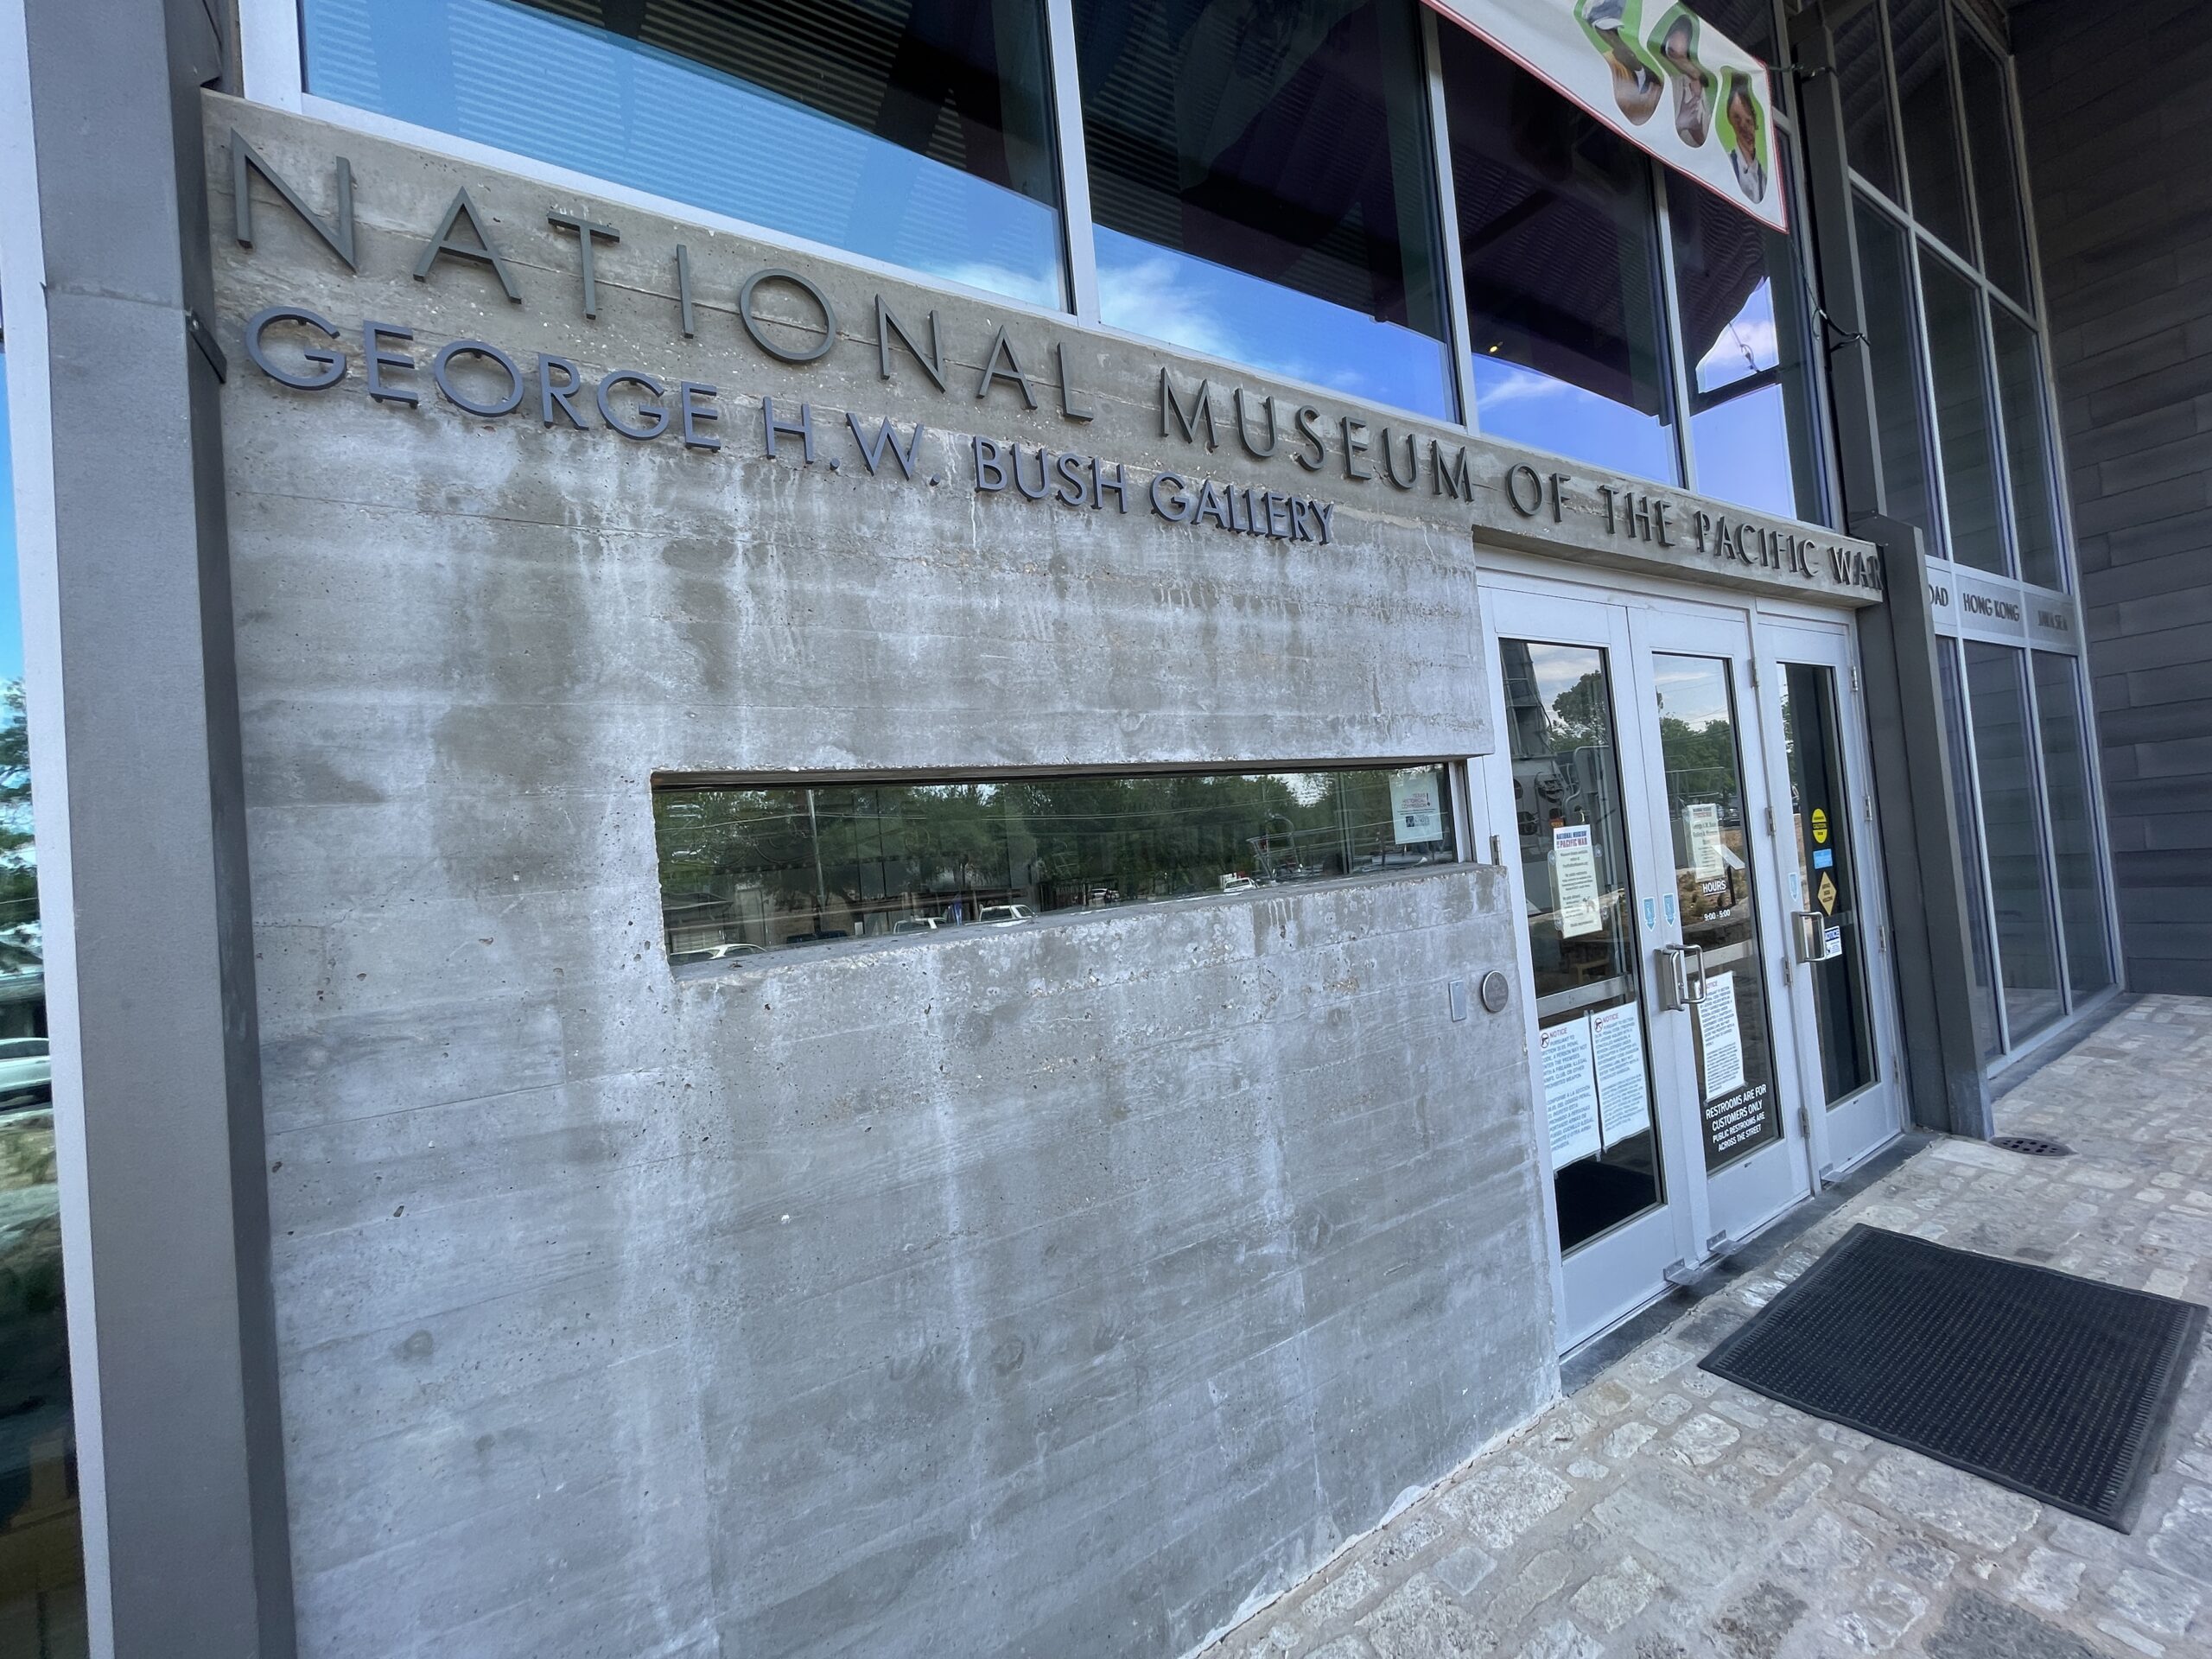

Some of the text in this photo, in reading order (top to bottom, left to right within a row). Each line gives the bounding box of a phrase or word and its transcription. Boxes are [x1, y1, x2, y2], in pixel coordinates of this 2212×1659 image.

[231, 128, 1883, 590] NATIONAL MUSEUM OF THE PACIFIC WAR
[245, 306, 721, 454] GEORGE
[972, 436, 1128, 513] BUSH
[1150, 473, 1335, 545] GALLERY
[1928, 584, 1948, 607] OAD
[1963, 593, 2020, 622] HONG KONG
[1702, 880, 1726, 893] HOURS
[1704, 912, 1716, 921] 9:00
[1719, 909, 1731, 919] 5:00
[1603, 1013, 1618, 1022] NOTICE
[1549, 1027, 1567, 1038] NOTICE
[1706, 1084, 1767, 1120] RESTROOMS ARE FOR
[1712, 1099, 1763, 1132] CUSTOMERS ONLY
[1713, 1111, 1765, 1143] PUBLIC RESTROOMS ARE
[1719, 1123, 1761, 1152] ACROSS THE STREET
